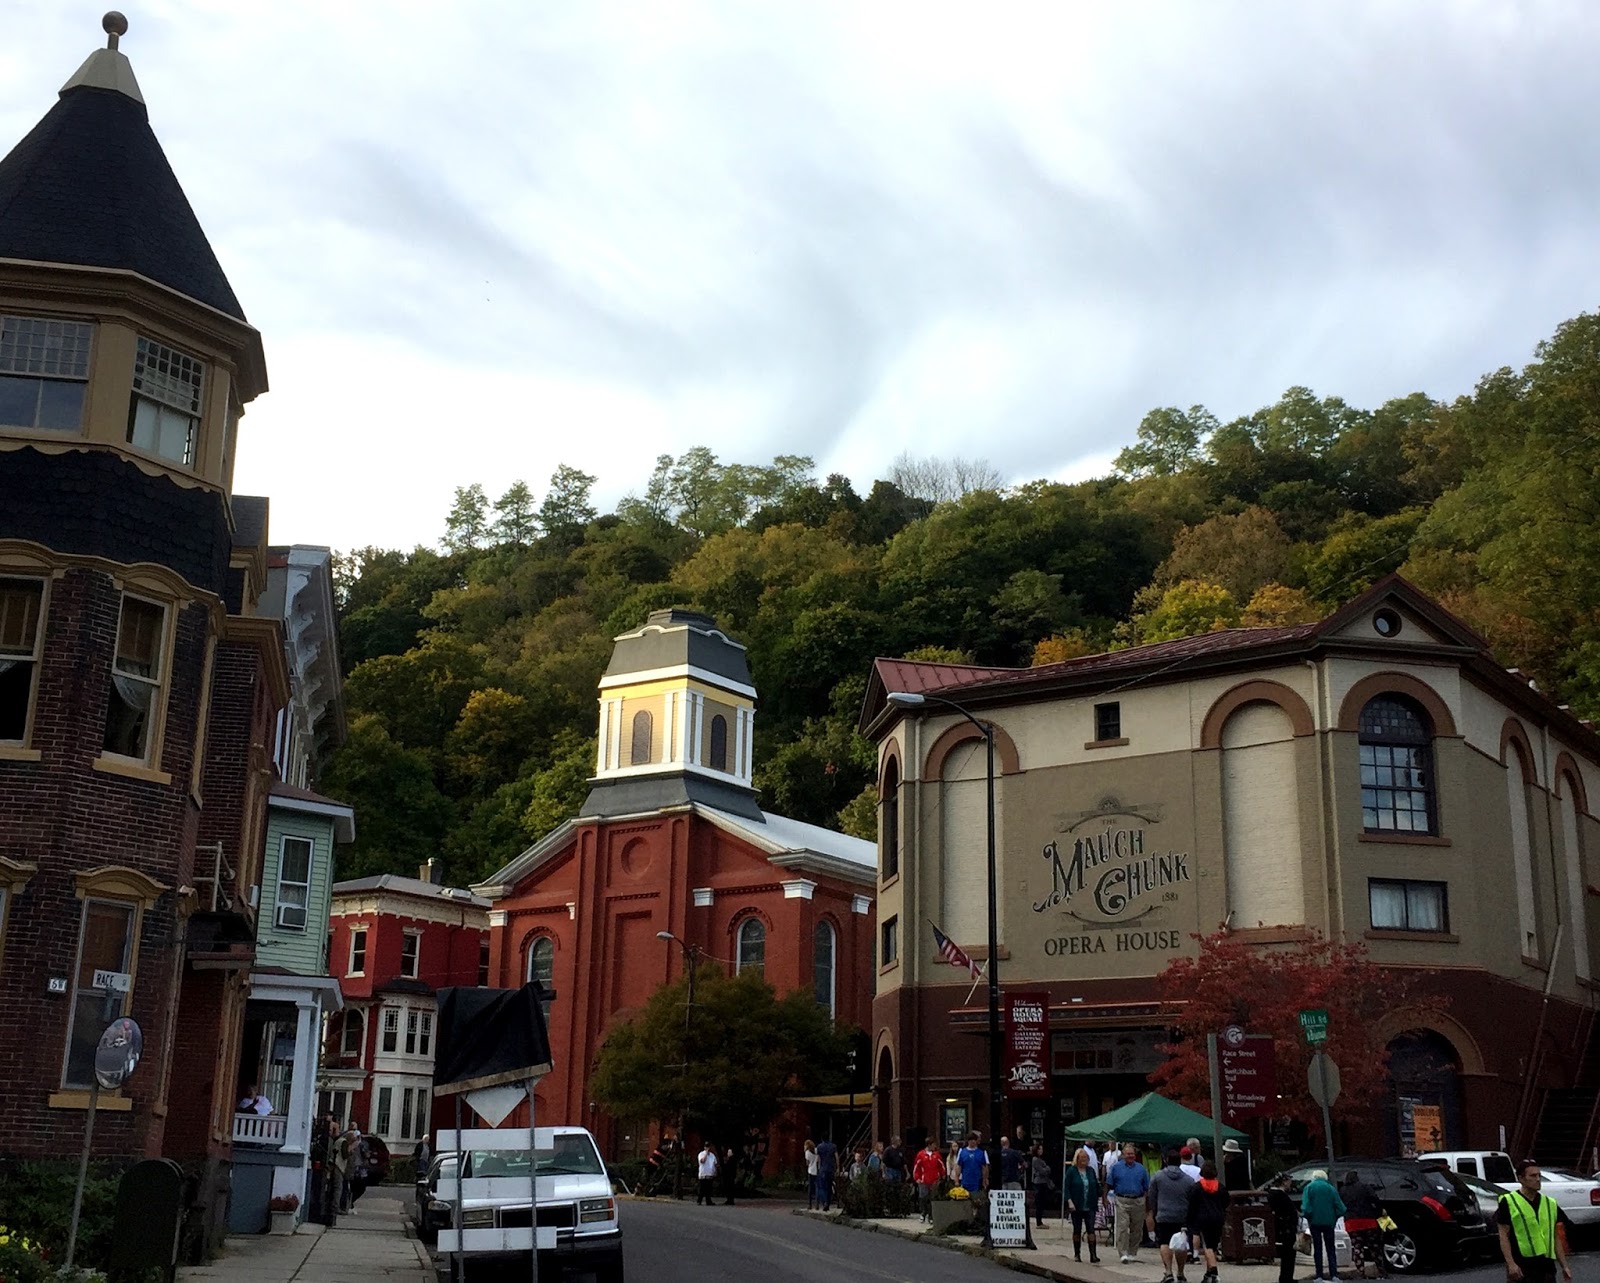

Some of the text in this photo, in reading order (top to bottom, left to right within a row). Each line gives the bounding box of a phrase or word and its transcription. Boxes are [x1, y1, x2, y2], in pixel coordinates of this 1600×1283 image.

[1033, 826, 1144, 913] MAUCH
[1093, 850, 1190, 915] CHUNK
[1162, 892, 1178, 902] 1881
[1044, 930, 1180, 956] OPERA HOUSE
[96, 973, 115, 988] RACE
[1300, 1013, 1316, 1025] Hill
